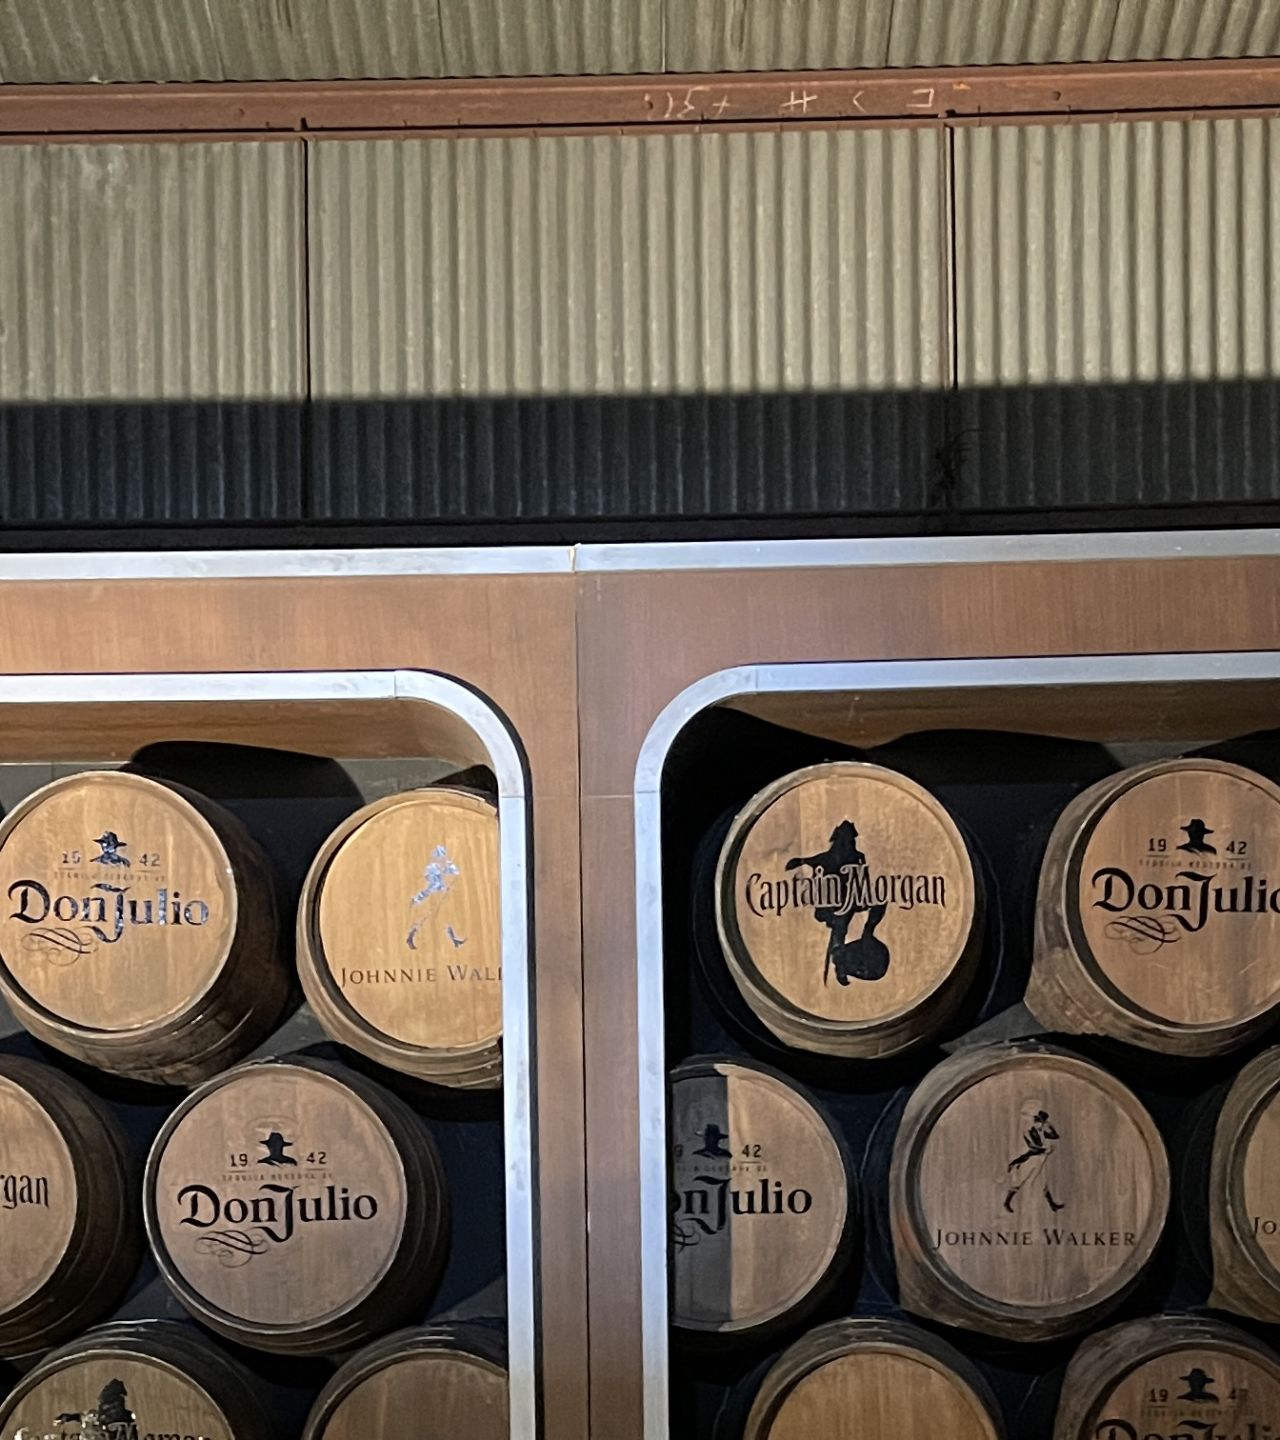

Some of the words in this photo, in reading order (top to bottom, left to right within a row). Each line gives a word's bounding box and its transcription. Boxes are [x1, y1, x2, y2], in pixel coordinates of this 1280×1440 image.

[1148, 837, 1167, 852] 19
[1226, 840, 1248, 855] 42
[138, 853, 161, 868] 42
[745, 865, 842, 918] Captain
[834, 862, 946, 916] Morgan
[341, 967, 438, 988] JOHNNIE
[446, 964, 502, 982] WAL
[230, 1153, 248, 1167] 19
[306, 1151, 327, 1165] 42
[741, 1144, 762, 1158] 42
[934, 1228, 1033, 1250] JOHNNIE
[1043, 1228, 1137, 1247] WALKER
[1149, 1388, 1169, 1403] 19
